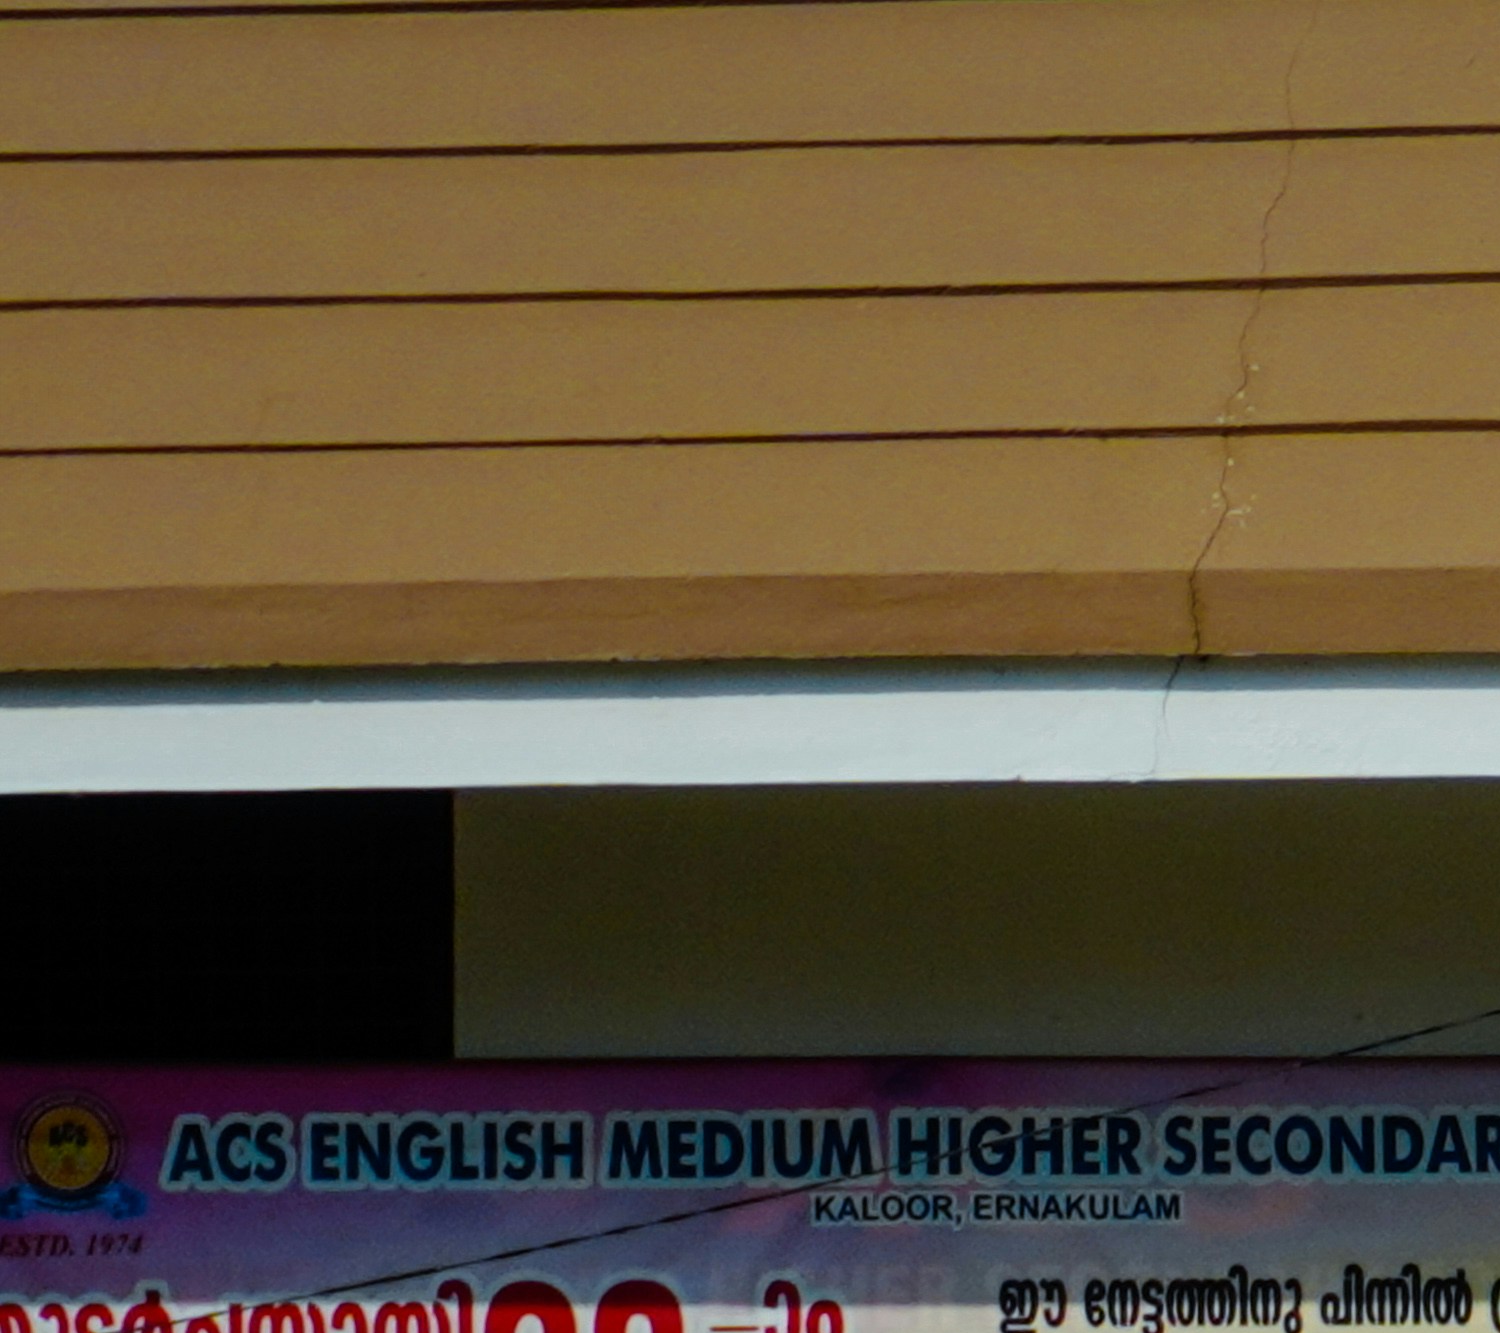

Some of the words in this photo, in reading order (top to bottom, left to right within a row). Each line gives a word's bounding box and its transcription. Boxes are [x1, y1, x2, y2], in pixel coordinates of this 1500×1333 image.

[168, 1118, 288, 1182] ACS
[312, 1118, 586, 1182] ENGLISH
[609, 1116, 874, 1180] MEDIUM
[898, 1114, 1142, 1176] HIGHER
[813, 1194, 963, 1225] KALOOR,
[973, 1193, 1182, 1223] ERNAKULAM
[88, 1232, 146, 1257] 1974
[1318, 1262, 1474, 1328] പിന്നിൽ
